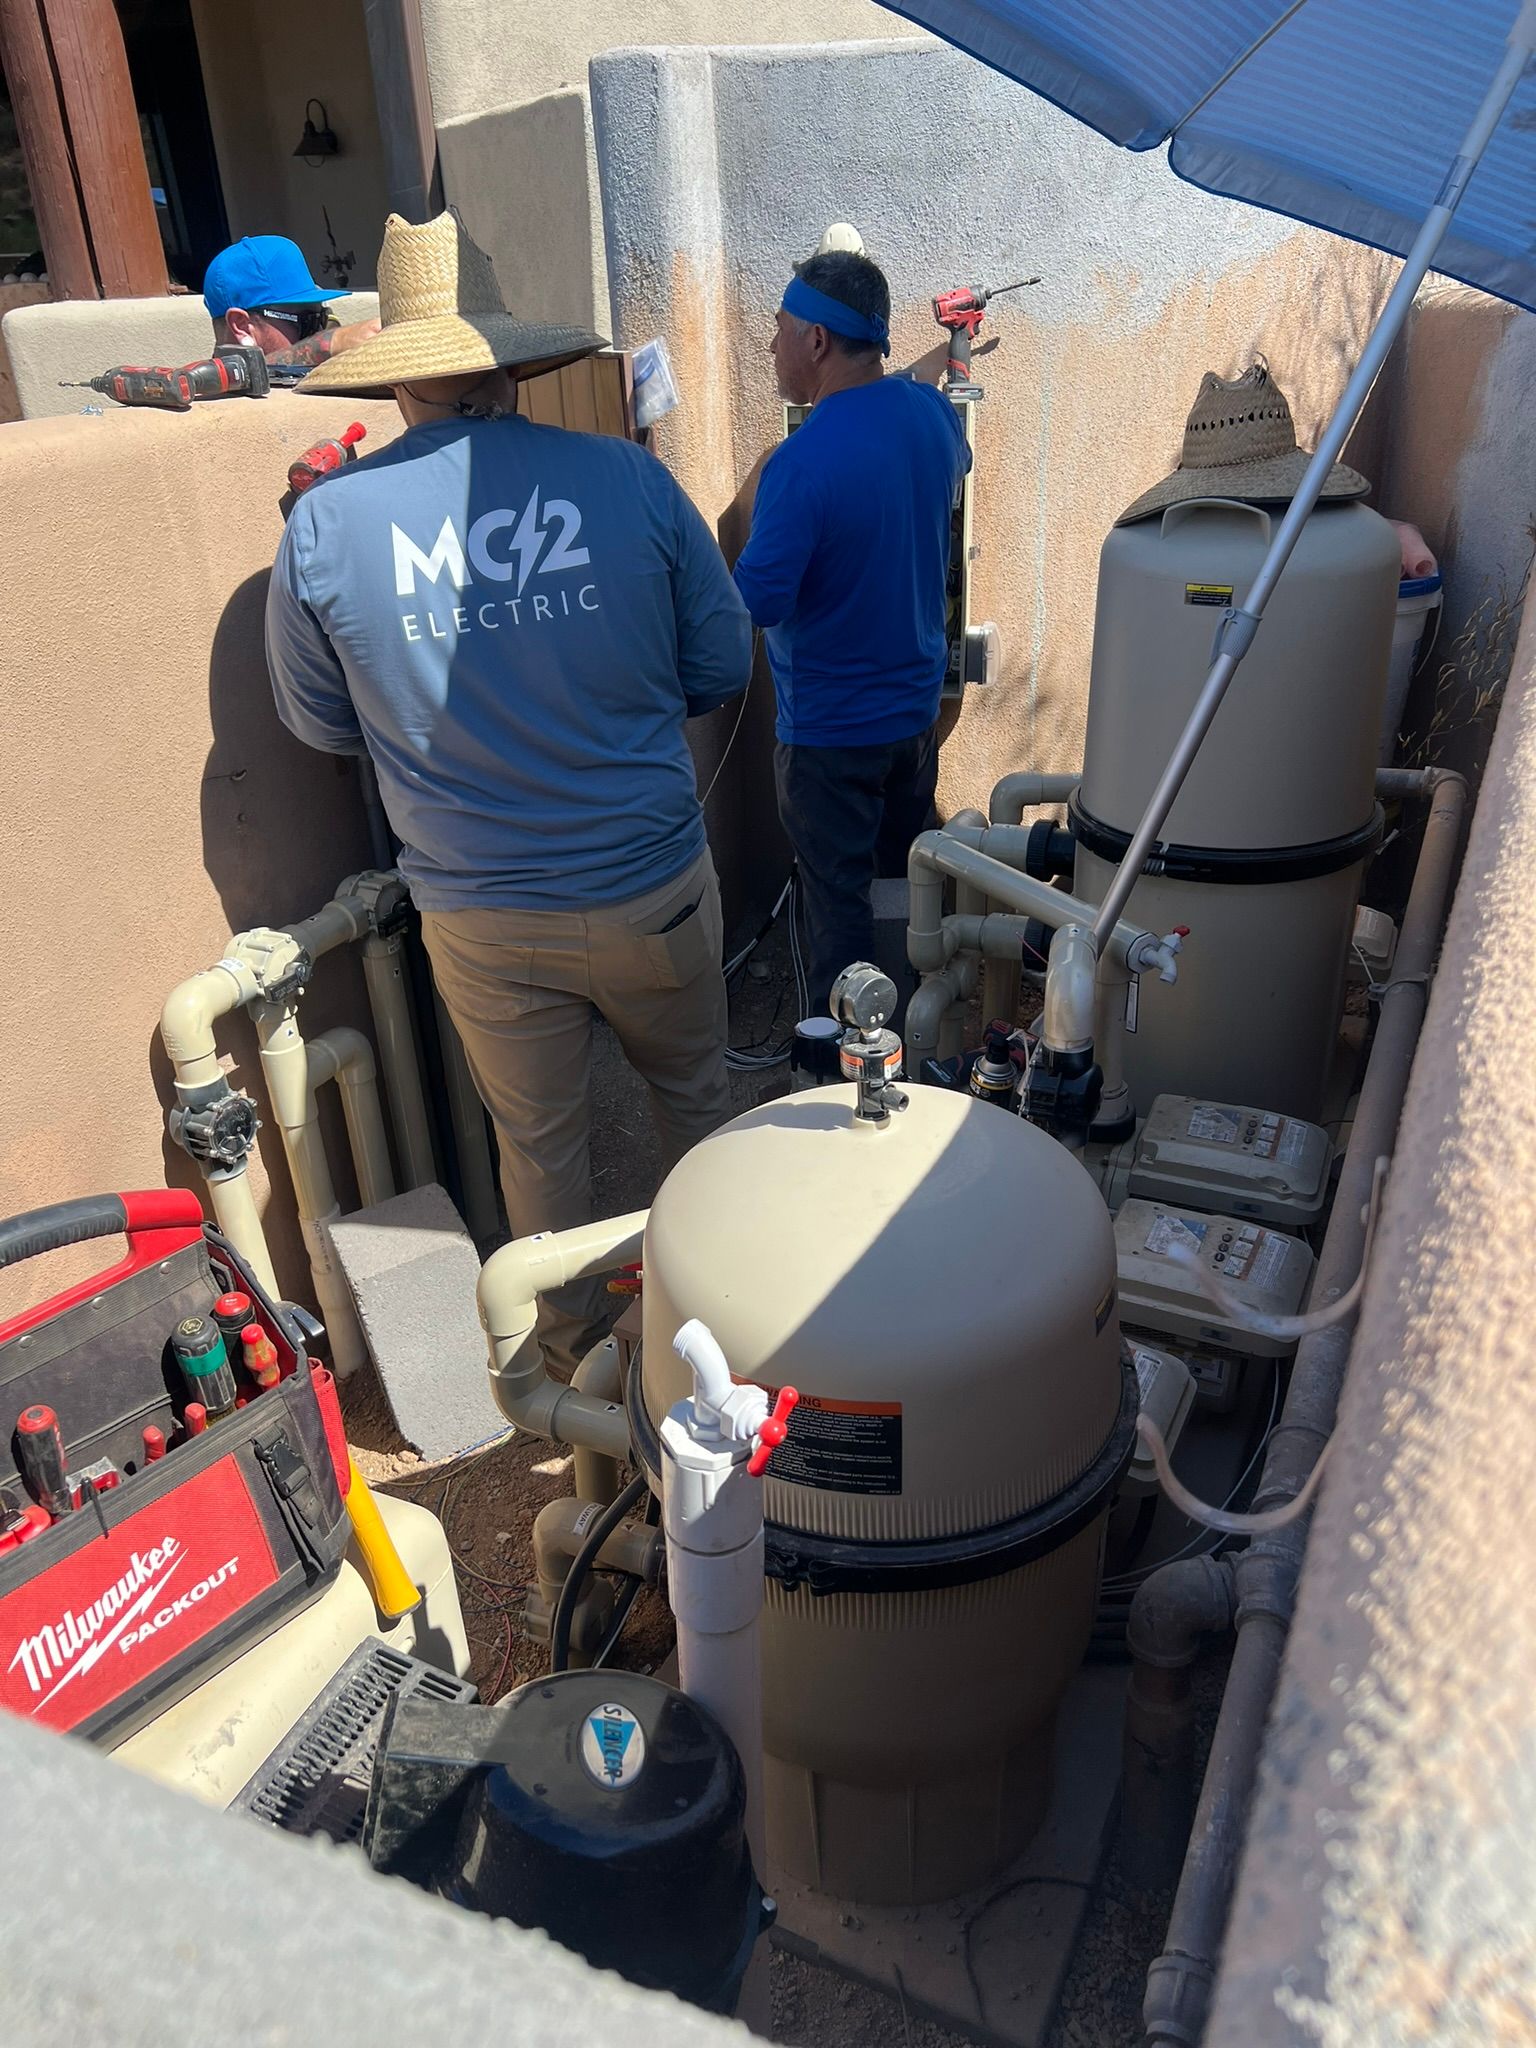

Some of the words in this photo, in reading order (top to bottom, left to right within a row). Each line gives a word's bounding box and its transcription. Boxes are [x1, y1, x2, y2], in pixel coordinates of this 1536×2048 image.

[402, 584, 600, 641] ELECTRIC
[762, 1385, 821, 1408] WAING
[8, 1536, 181, 1691] Milwaukee
[119, 1556, 239, 1655] PACKOUT
[603, 1705, 623, 1778] SILENCER
